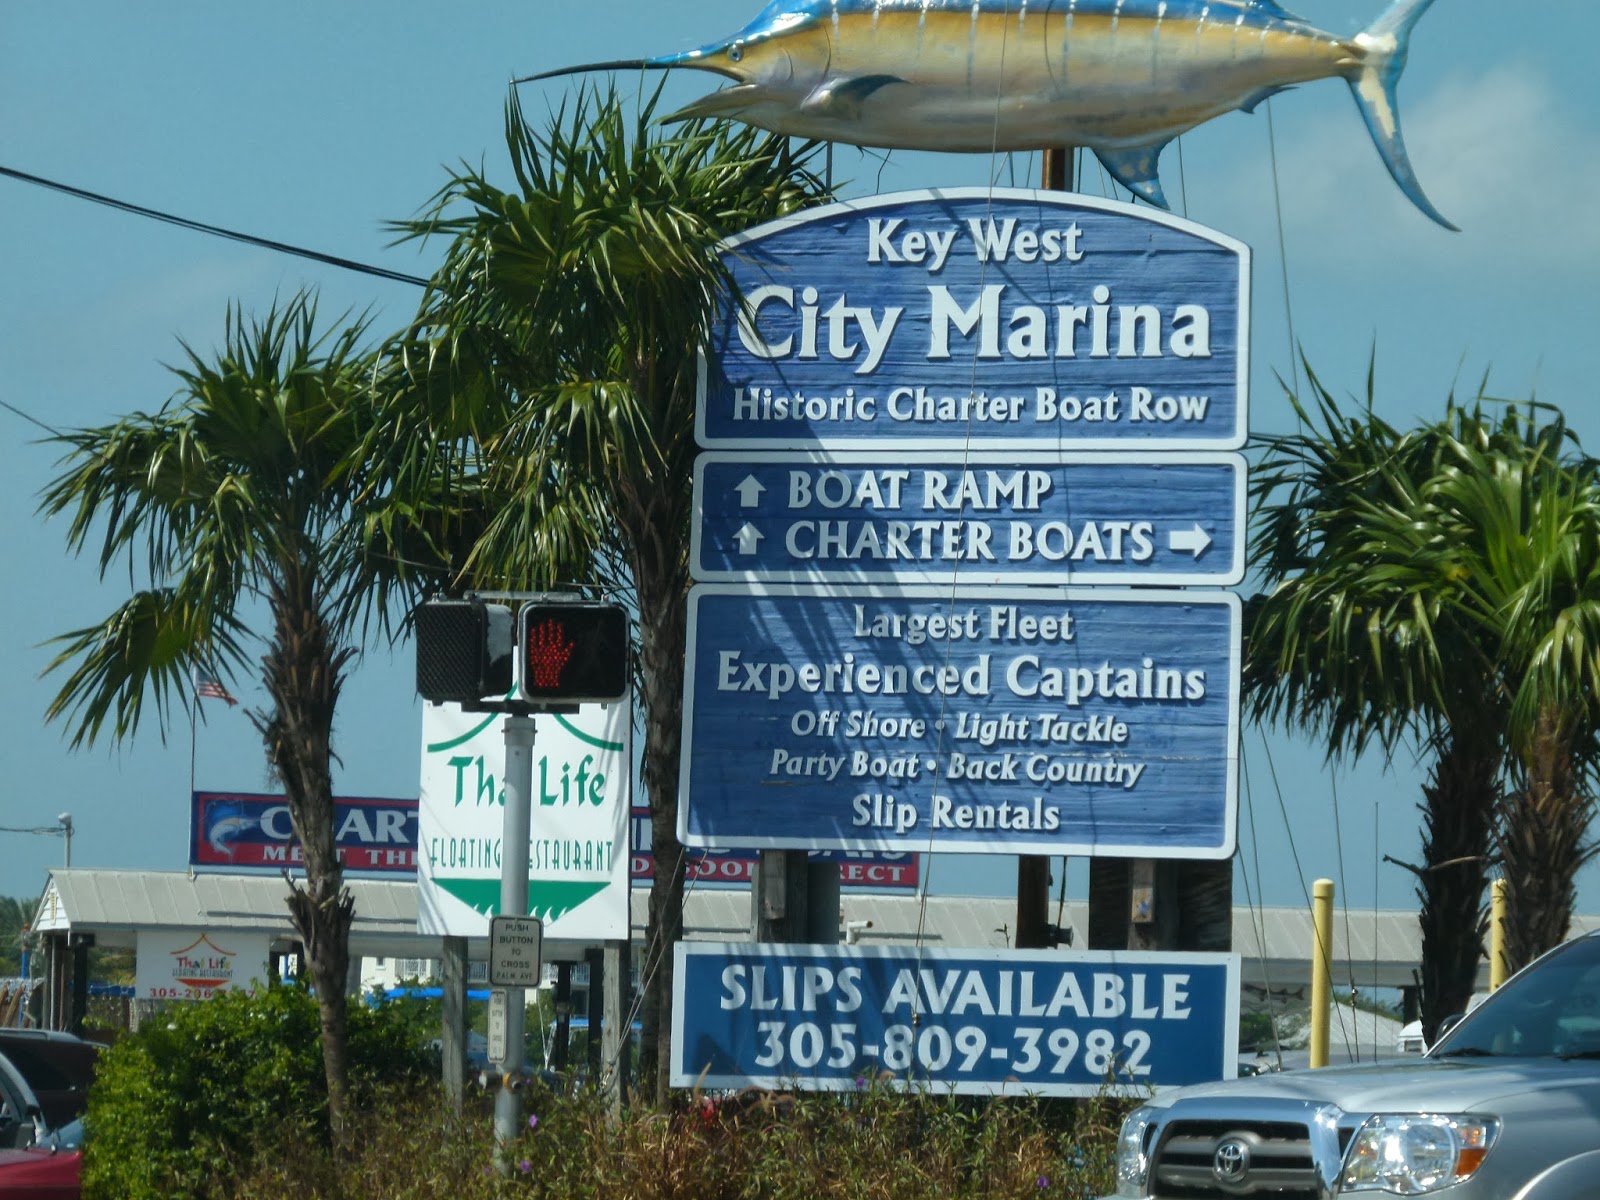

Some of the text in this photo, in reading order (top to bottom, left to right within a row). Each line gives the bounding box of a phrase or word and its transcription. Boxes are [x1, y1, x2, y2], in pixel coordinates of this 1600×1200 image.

[866, 215, 1085, 273] Key West
[736, 284, 1211, 376] City Marina
[733, 386, 1210, 424] Historic Charter Boat Row
[787, 469, 1053, 512] BOAT RAMP
[784, 519, 1156, 562] CHARTER BOATS
[853, 603, 1075, 645] Largest Fleet
[717, 650, 1207, 706] Experienced Captains
[790, 709, 1129, 746] Off Shore Light Tackle
[538, 754, 605, 807] Life
[769, 748, 1146, 789] Party Boat Back Country
[851, 793, 1061, 835] Slip Rentals
[263, 845, 346, 863] MET
[430, 838, 501, 868] FLOATING
[529, 840, 612, 871] ESTAURANT
[499, 936, 533, 944] BUTTON
[512, 948, 521, 956] TO
[501, 961, 530, 969] CROSS
[719, 964, 1193, 1021] SLIPS AVAILABLE
[753, 1021, 1153, 1076] 305-809-3982
